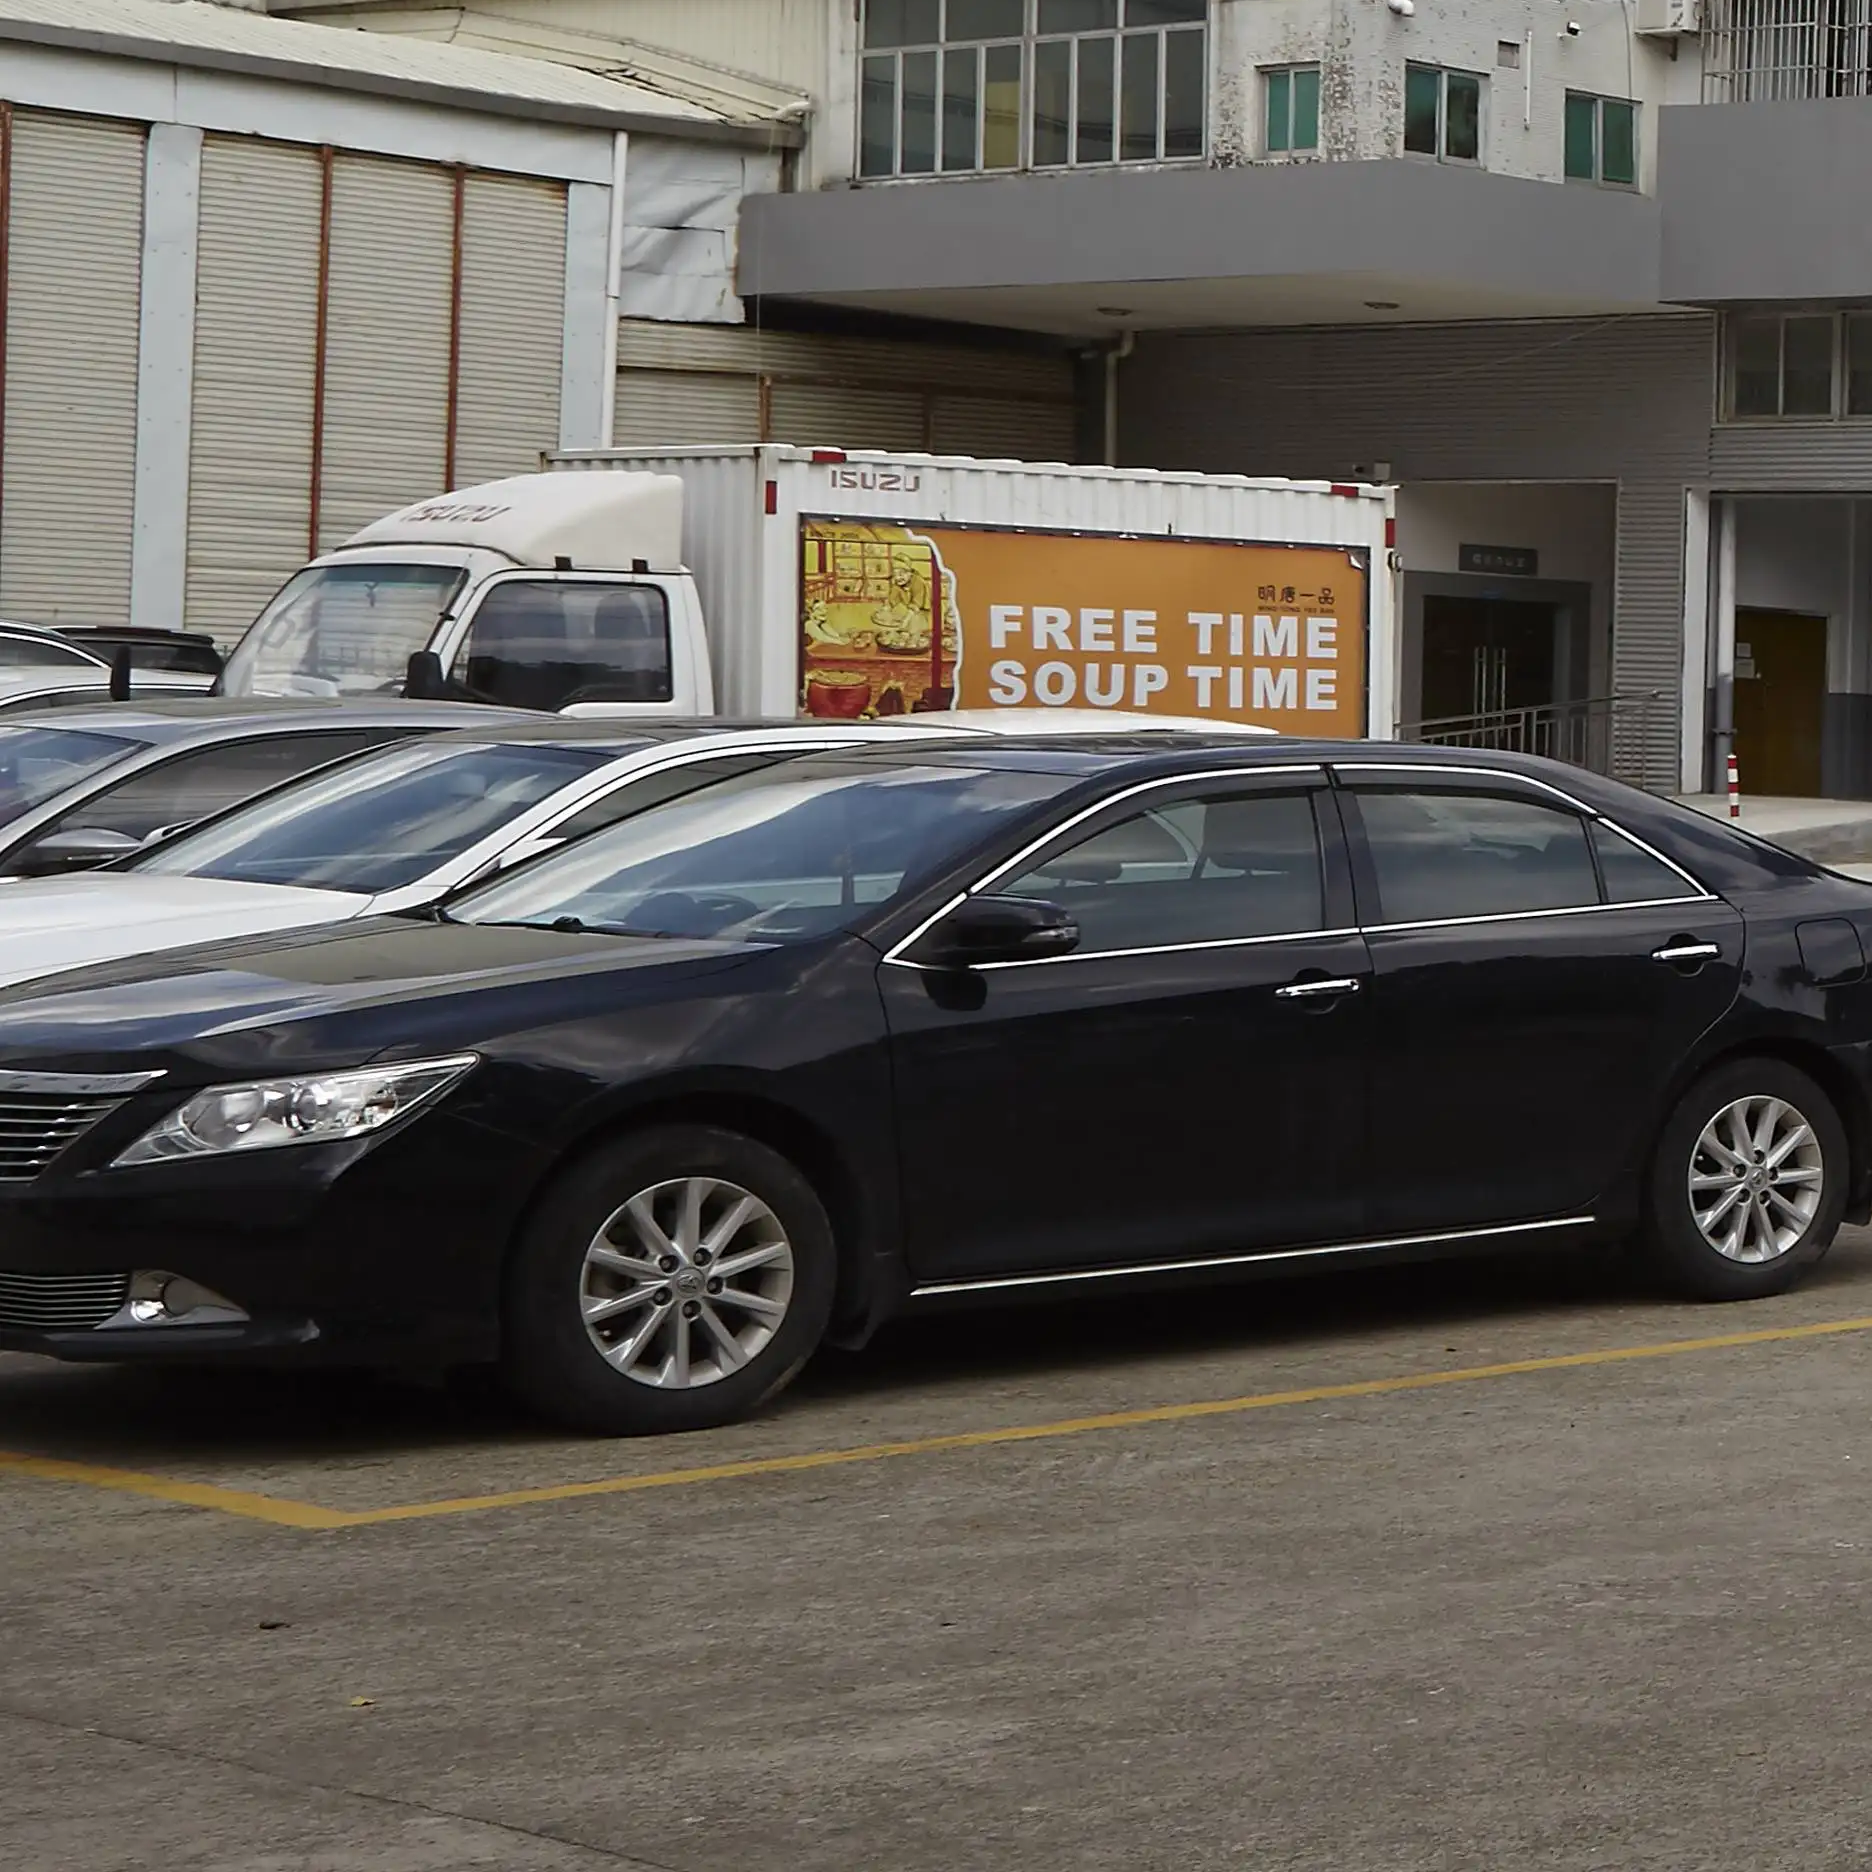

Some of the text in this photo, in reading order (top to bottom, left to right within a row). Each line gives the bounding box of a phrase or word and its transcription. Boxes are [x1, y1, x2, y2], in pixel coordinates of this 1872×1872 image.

[831, 470, 920, 492] ISUZU
[990, 604, 1338, 659] FREE TIME
[989, 660, 1338, 710] SOUP TIME
